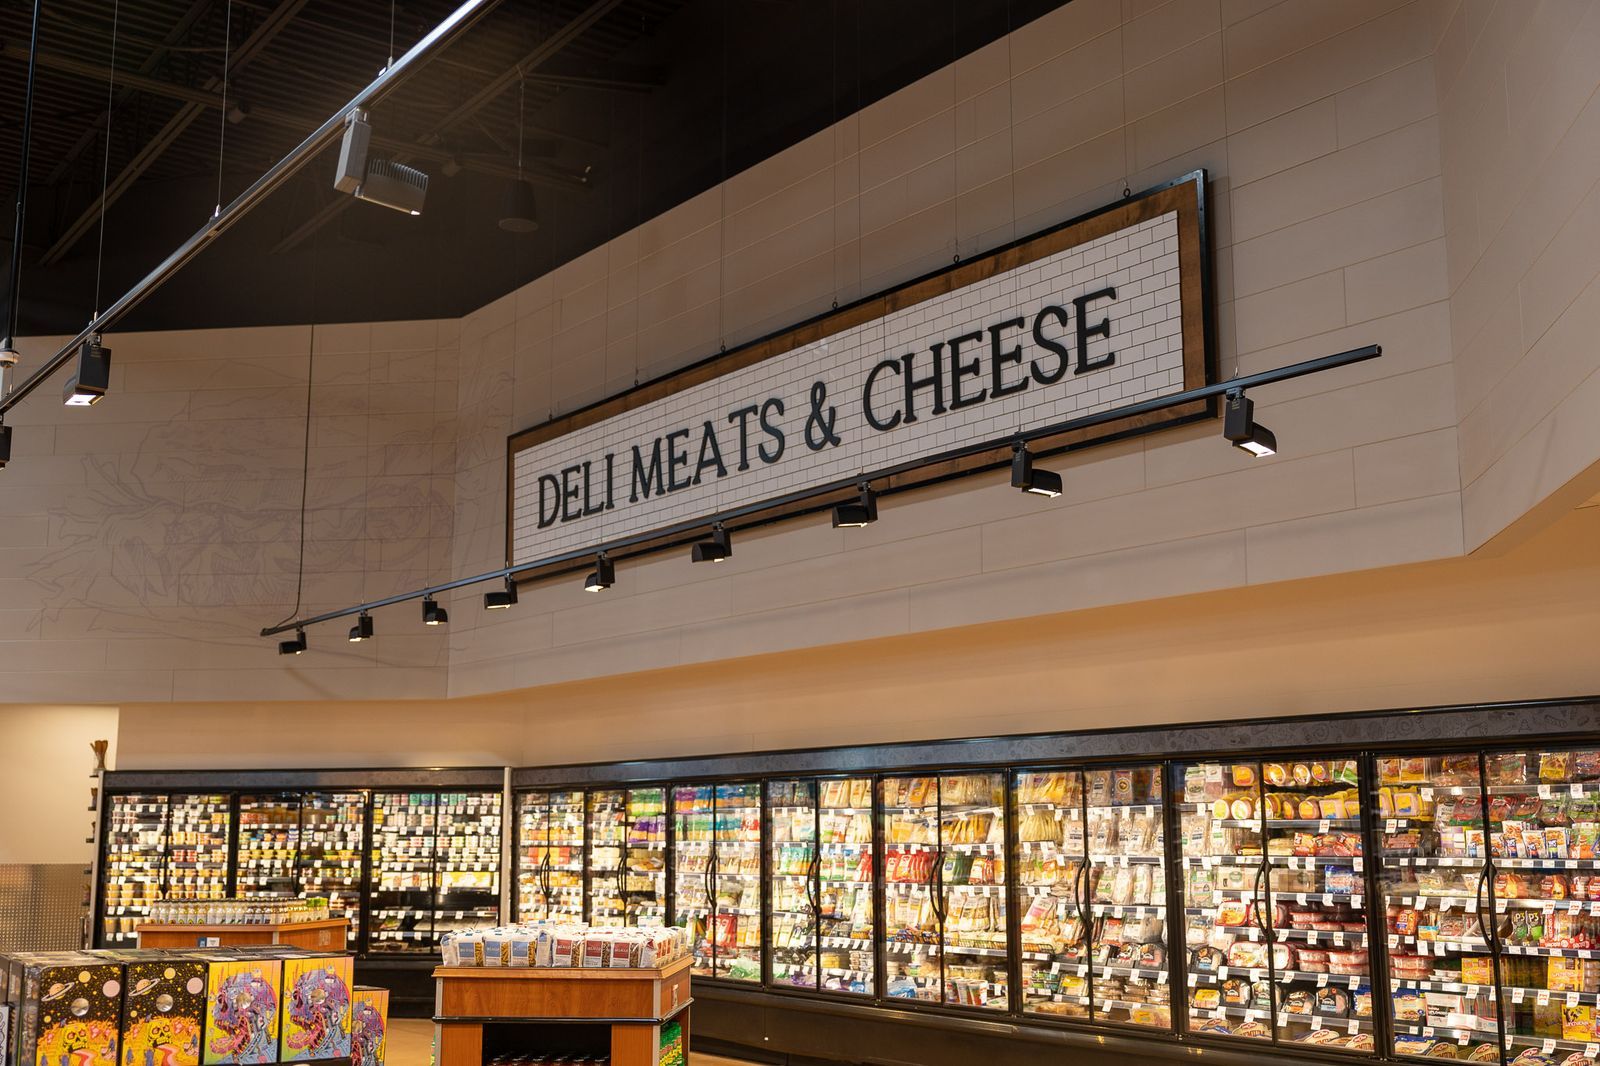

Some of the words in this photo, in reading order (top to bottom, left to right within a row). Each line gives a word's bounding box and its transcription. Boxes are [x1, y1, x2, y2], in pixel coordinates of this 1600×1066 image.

[536, 452, 615, 530] DELI
[628, 397, 786, 504] MEATS
[804, 380, 842, 452] &
[862, 286, 1118, 432] CHEESE
